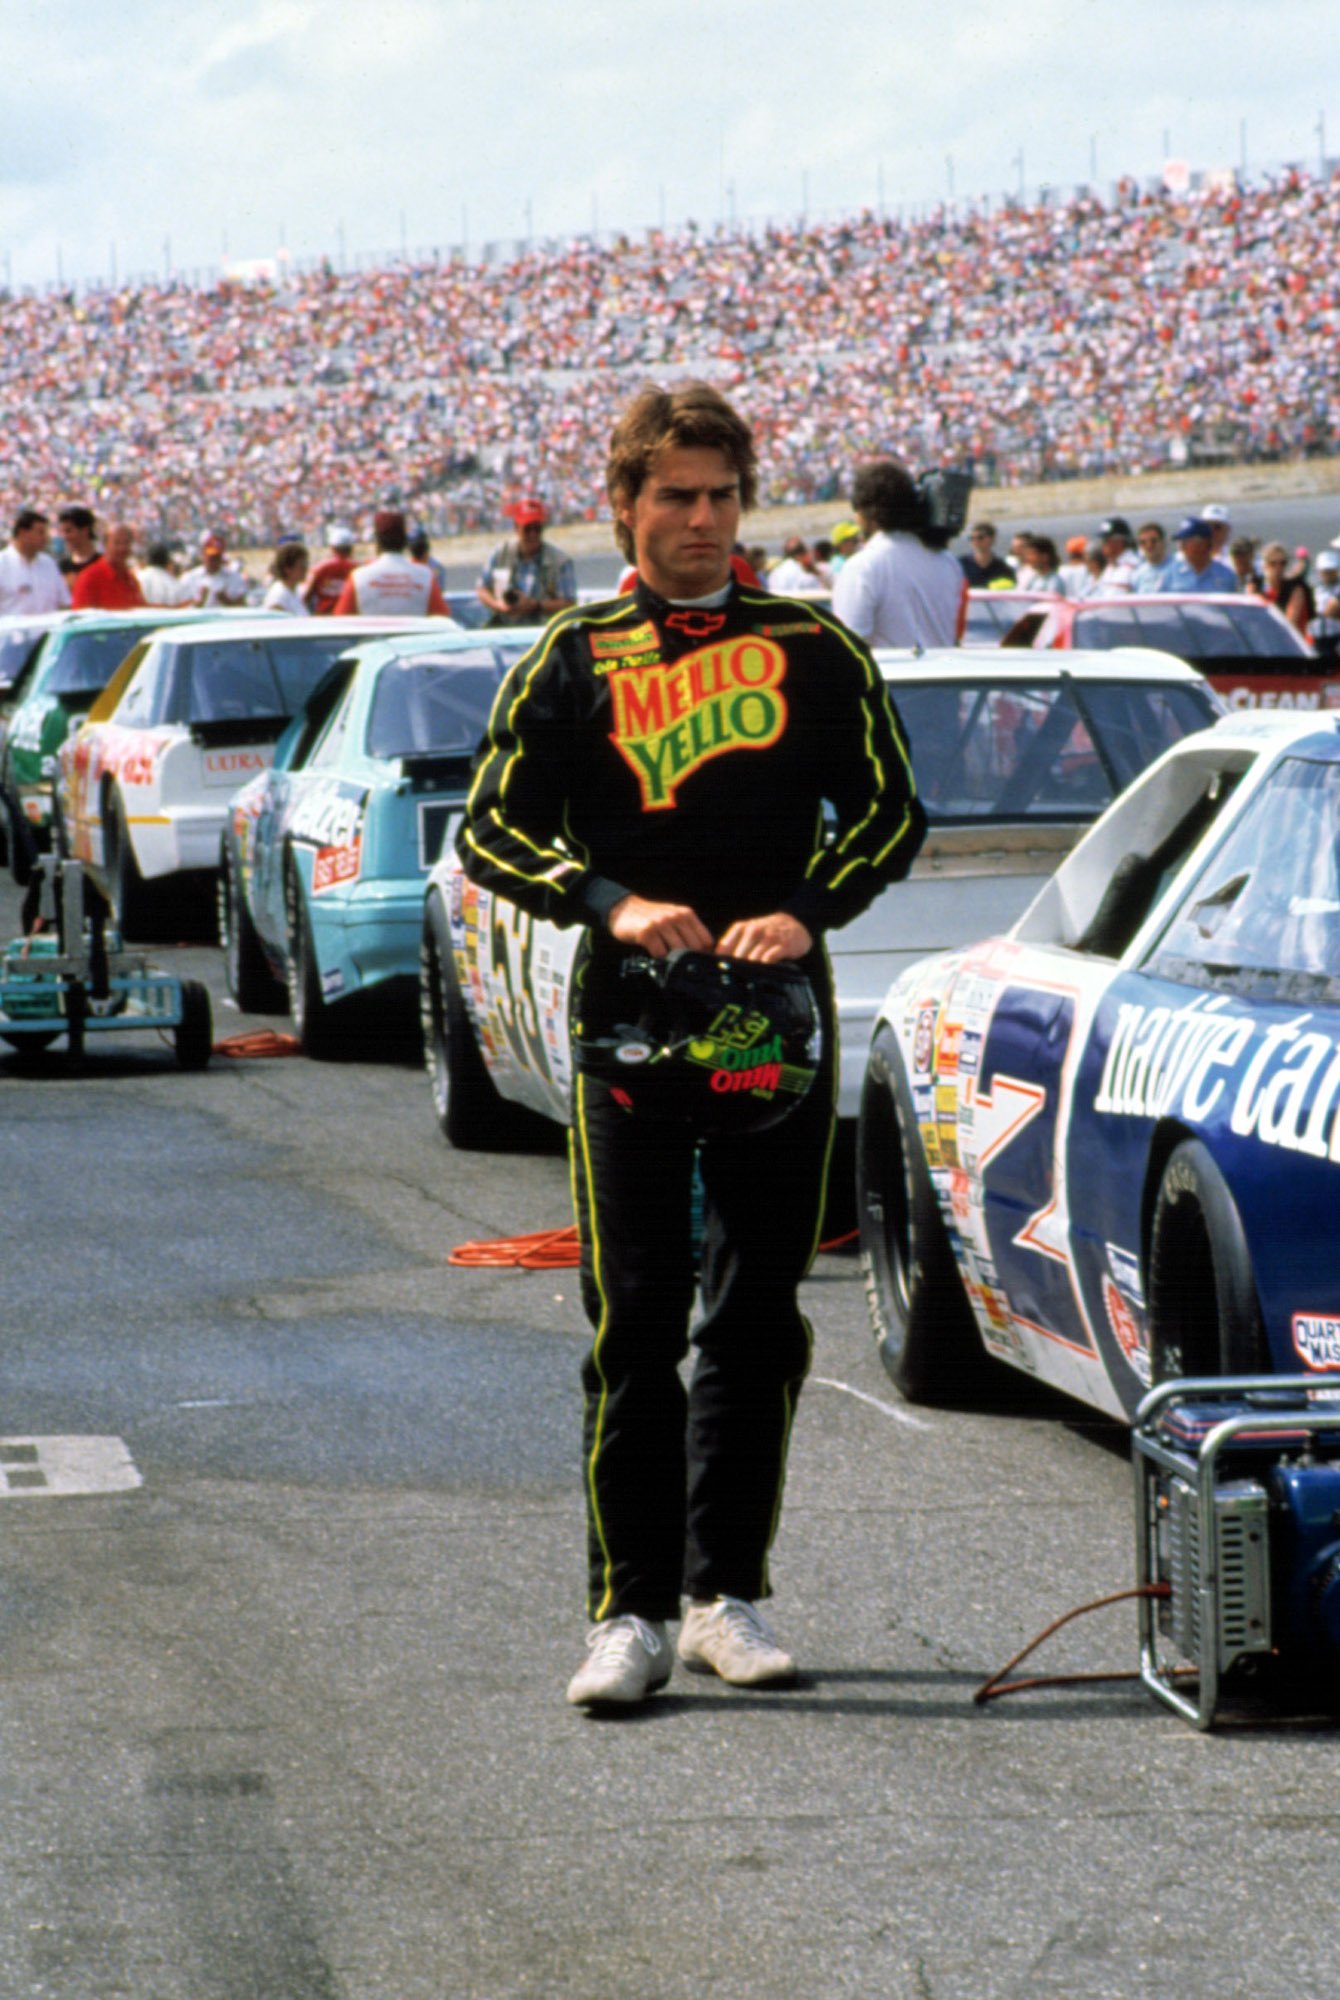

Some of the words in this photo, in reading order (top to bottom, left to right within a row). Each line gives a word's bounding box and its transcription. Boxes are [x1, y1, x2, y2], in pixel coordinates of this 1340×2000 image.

[619, 641, 777, 738] MELLO
[205, 752, 265, 773] ULTRA
[625, 690, 777, 802] YELLO
[709, 1062, 783, 1093] MELLO
[719, 1033, 784, 1071] YELLO
[1094, 993, 1256, 1122] native
[1231, 1013, 1340, 1165] ta
